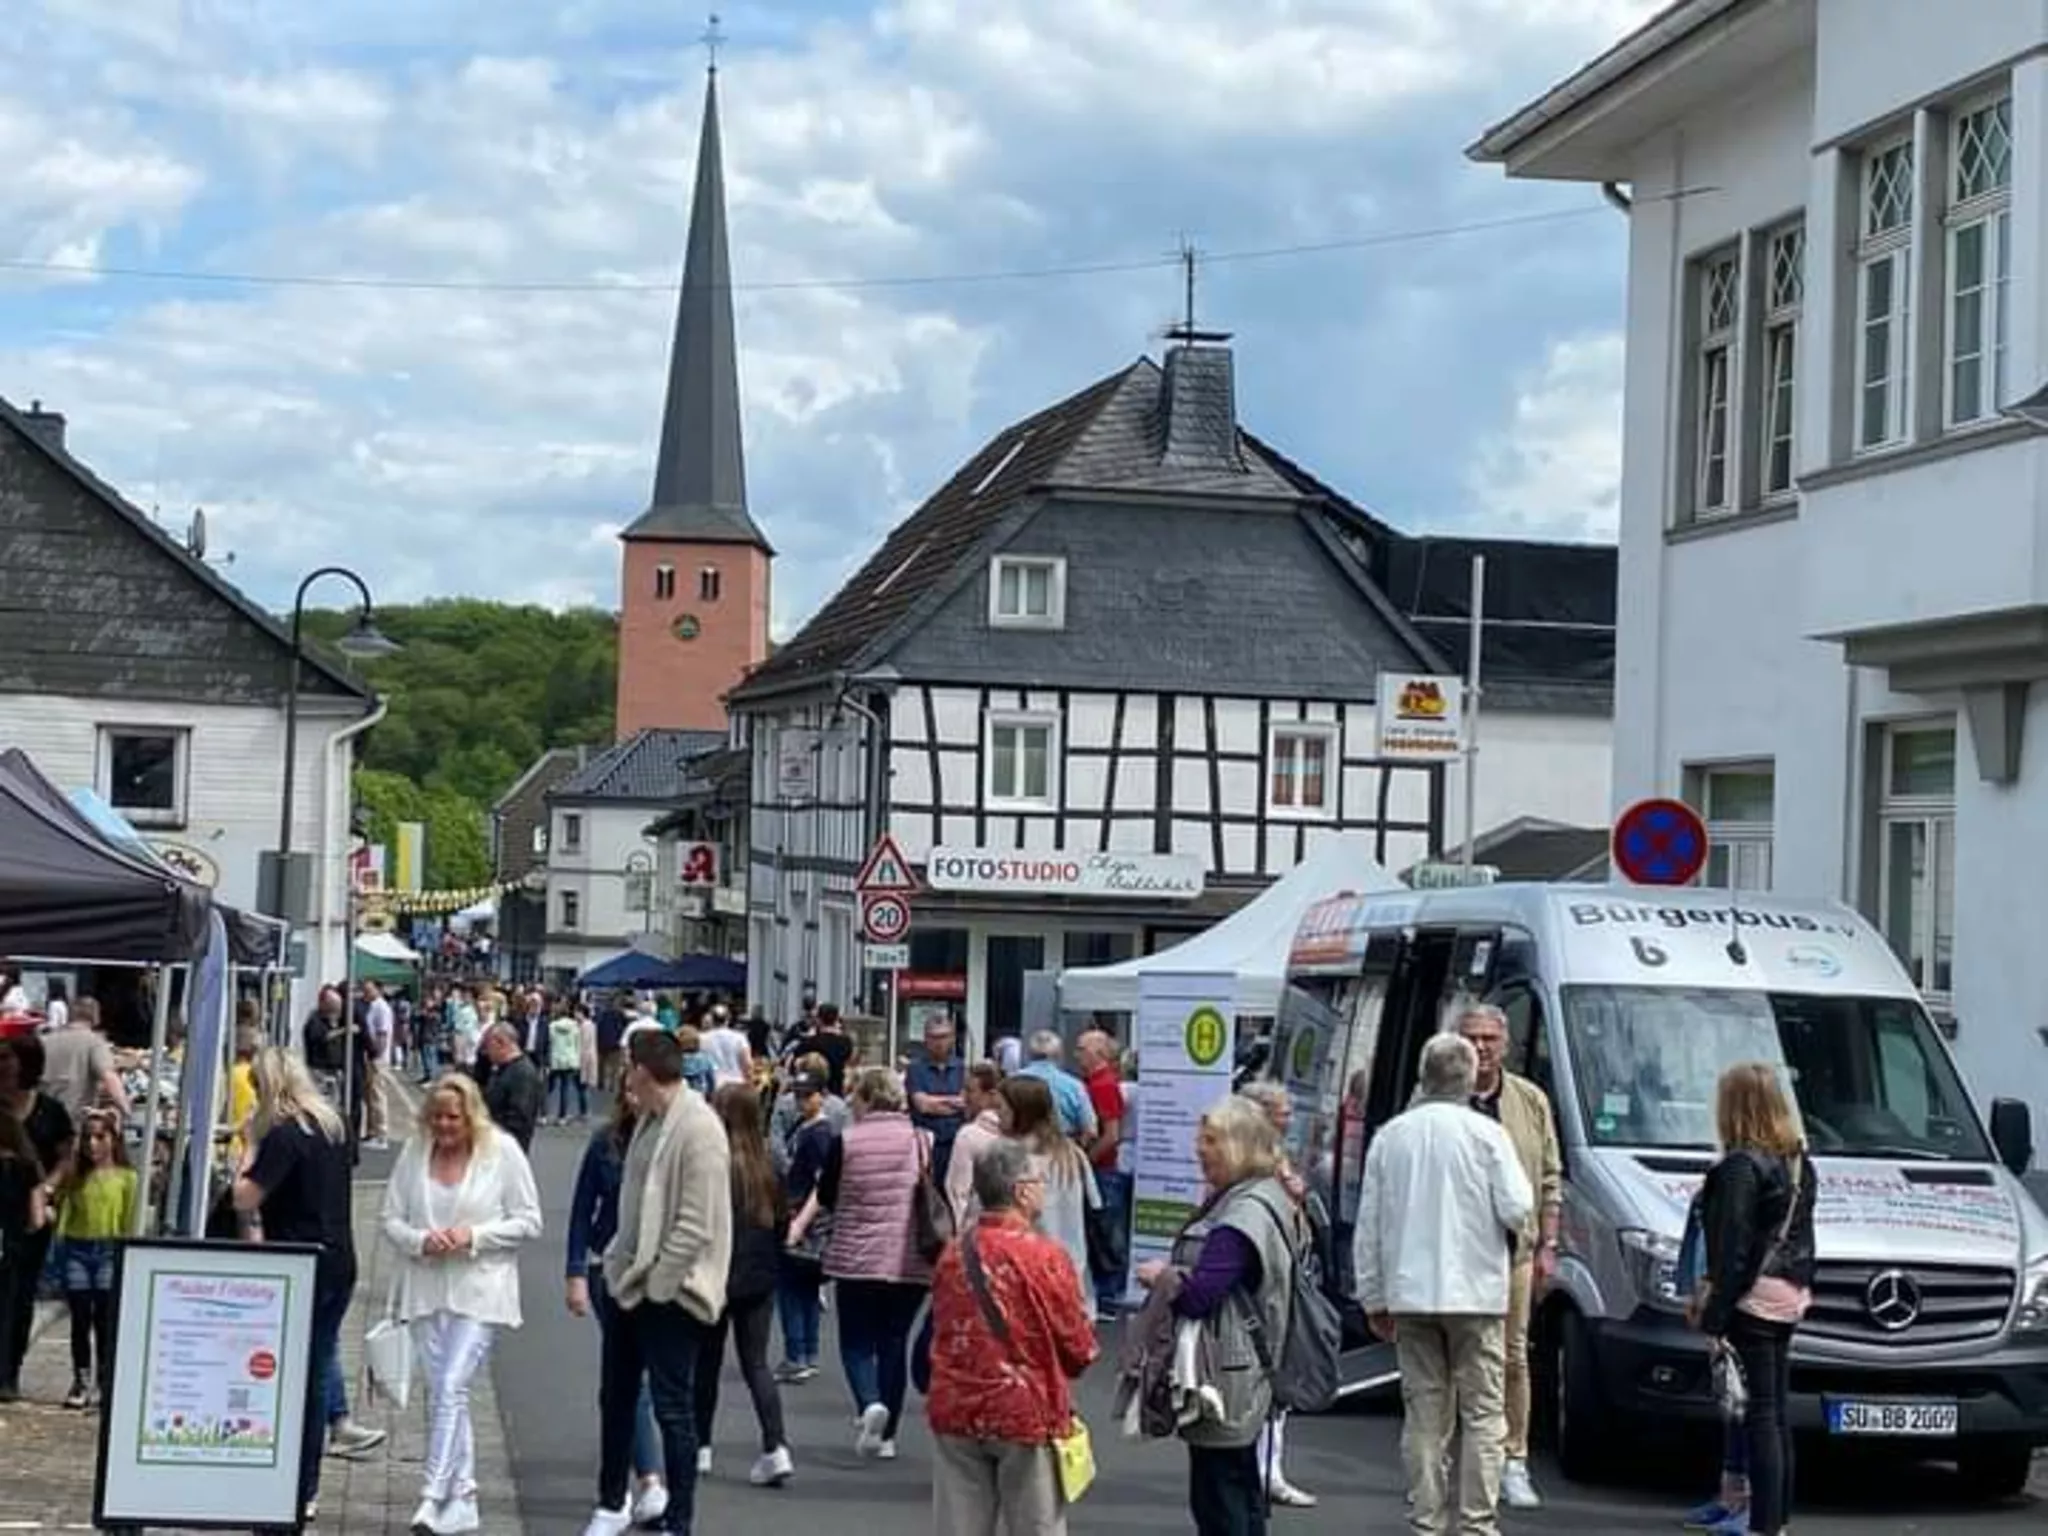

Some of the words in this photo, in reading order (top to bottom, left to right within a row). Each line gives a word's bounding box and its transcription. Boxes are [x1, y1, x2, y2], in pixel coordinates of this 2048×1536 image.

[935, 857, 1080, 882] FOTOSTUDIO
[873, 907, 900, 928] 20
[1570, 902, 1818, 931] Bürgerbus
[1843, 1406, 1867, 1429] SU
